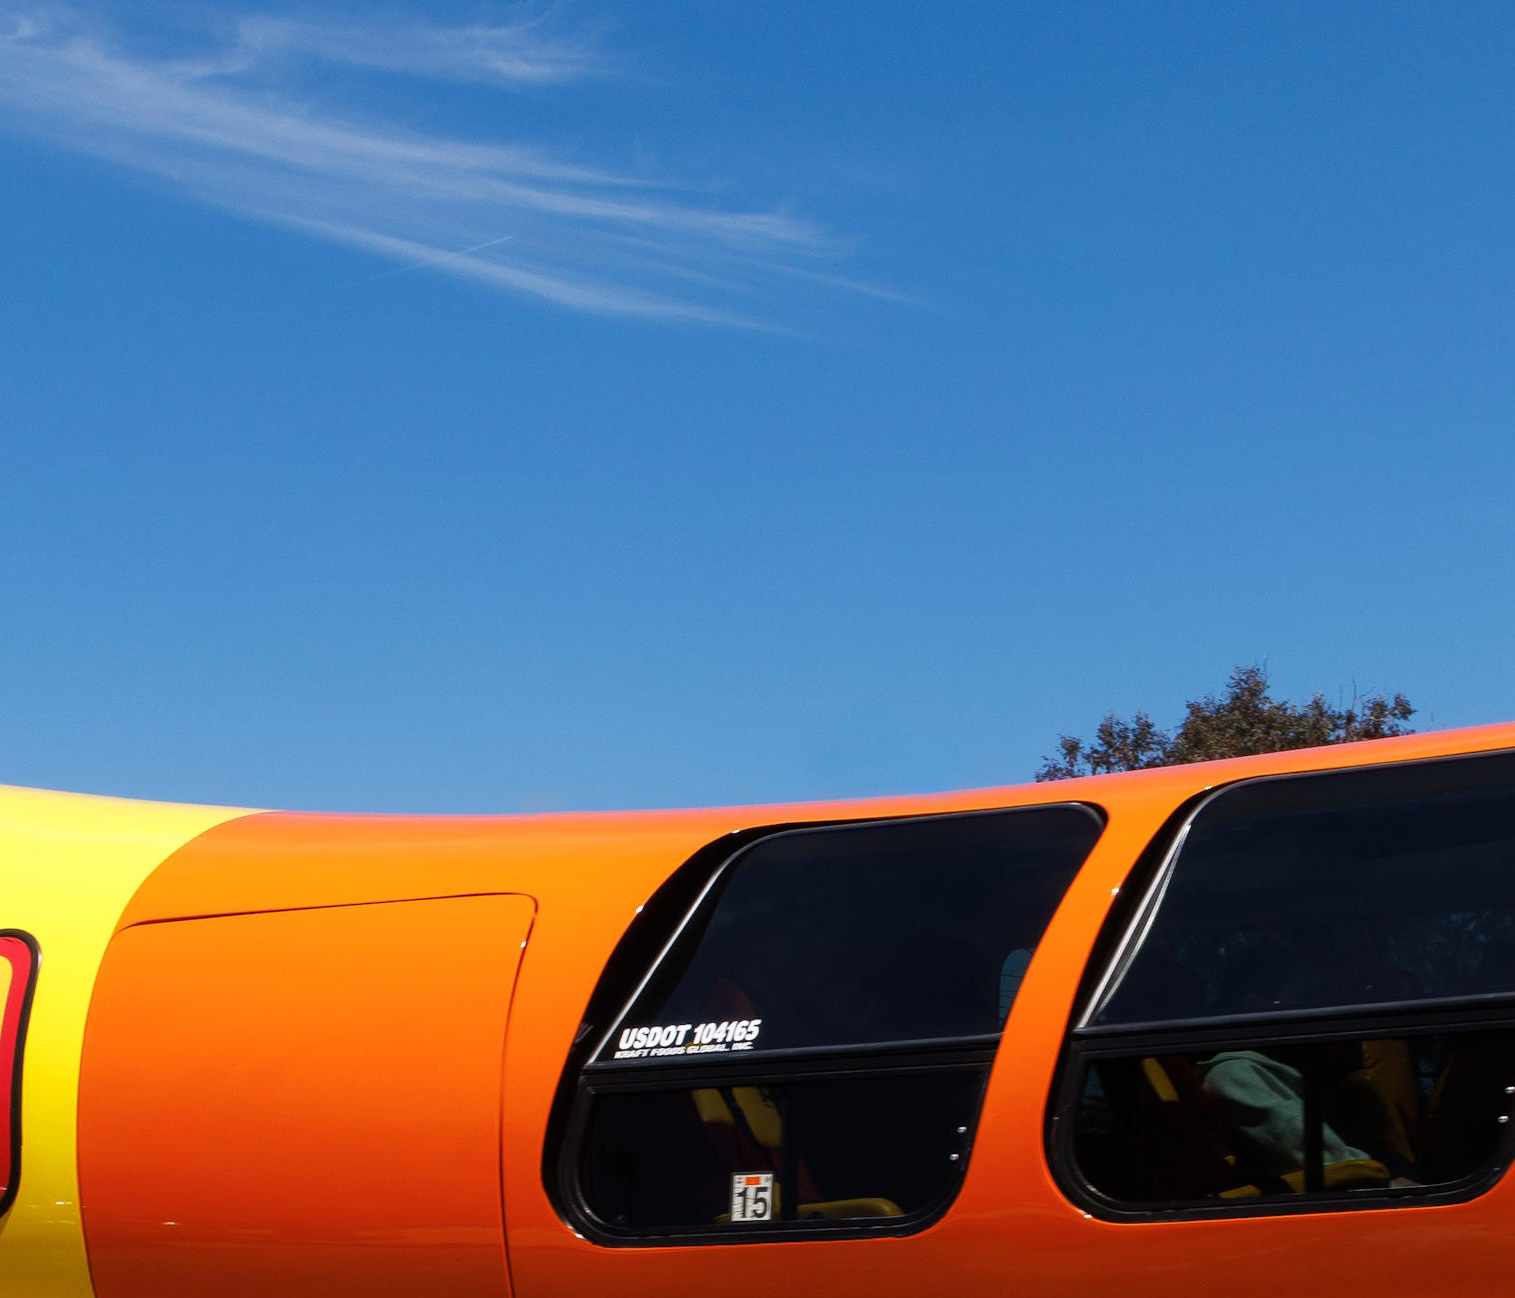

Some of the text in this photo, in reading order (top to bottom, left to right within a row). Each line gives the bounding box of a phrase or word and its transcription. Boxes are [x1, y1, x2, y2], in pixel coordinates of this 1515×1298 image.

[618, 1018, 763, 1050] USDOT 104165
[736, 1186, 769, 1219] 15
